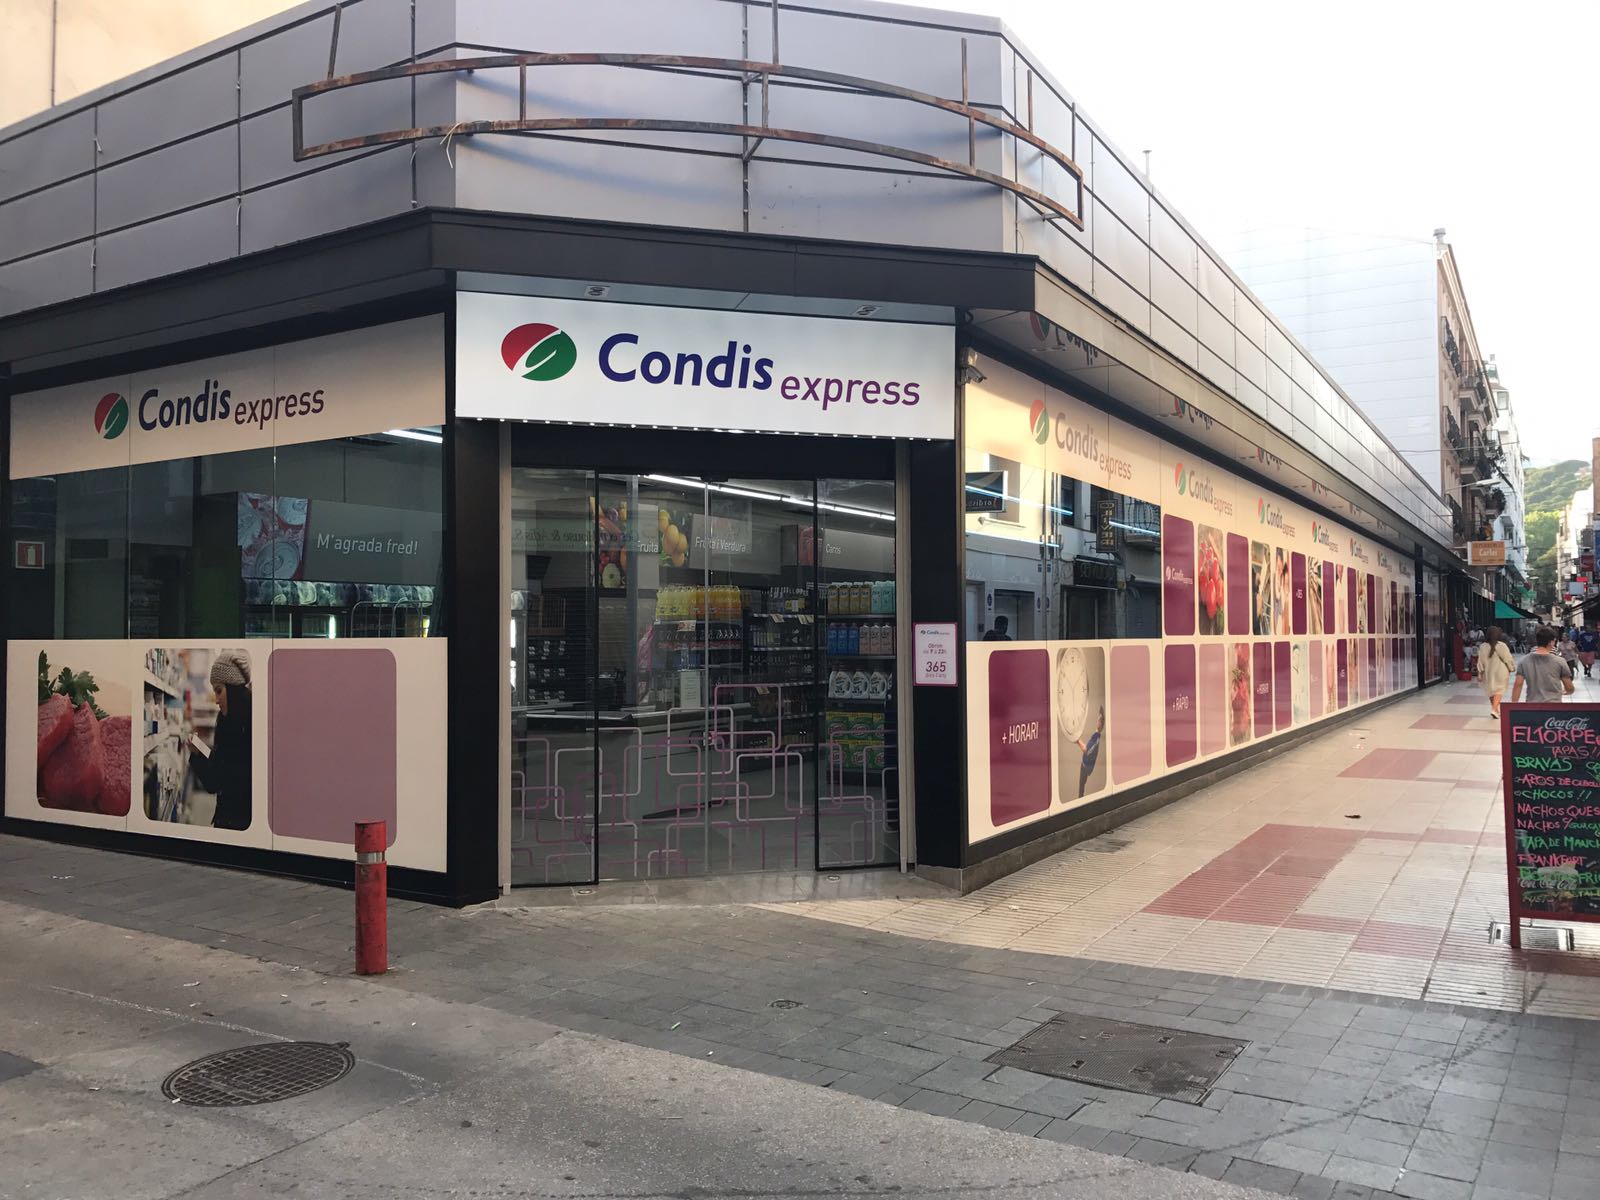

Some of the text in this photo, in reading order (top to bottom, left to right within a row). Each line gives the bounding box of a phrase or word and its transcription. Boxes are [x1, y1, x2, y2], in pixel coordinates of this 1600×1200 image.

[599, 333, 920, 411] Condis express
[138, 380, 325, 431] Condis express
[1055, 412, 1132, 480] Condis express
[1188, 470, 1213, 504] Condis
[317, 532, 418, 555] M'agrada fred!
[638, 540, 658, 552] ruita
[720, 540, 746, 552] Verdura
[925, 661, 946, 673] 365
[1008, 721, 1039, 745] HORARI
[1514, 756, 1573, 771] BRAVAS
[1517, 803, 1565, 818] NACHOS
[1517, 819, 1561, 832] NACHOS
